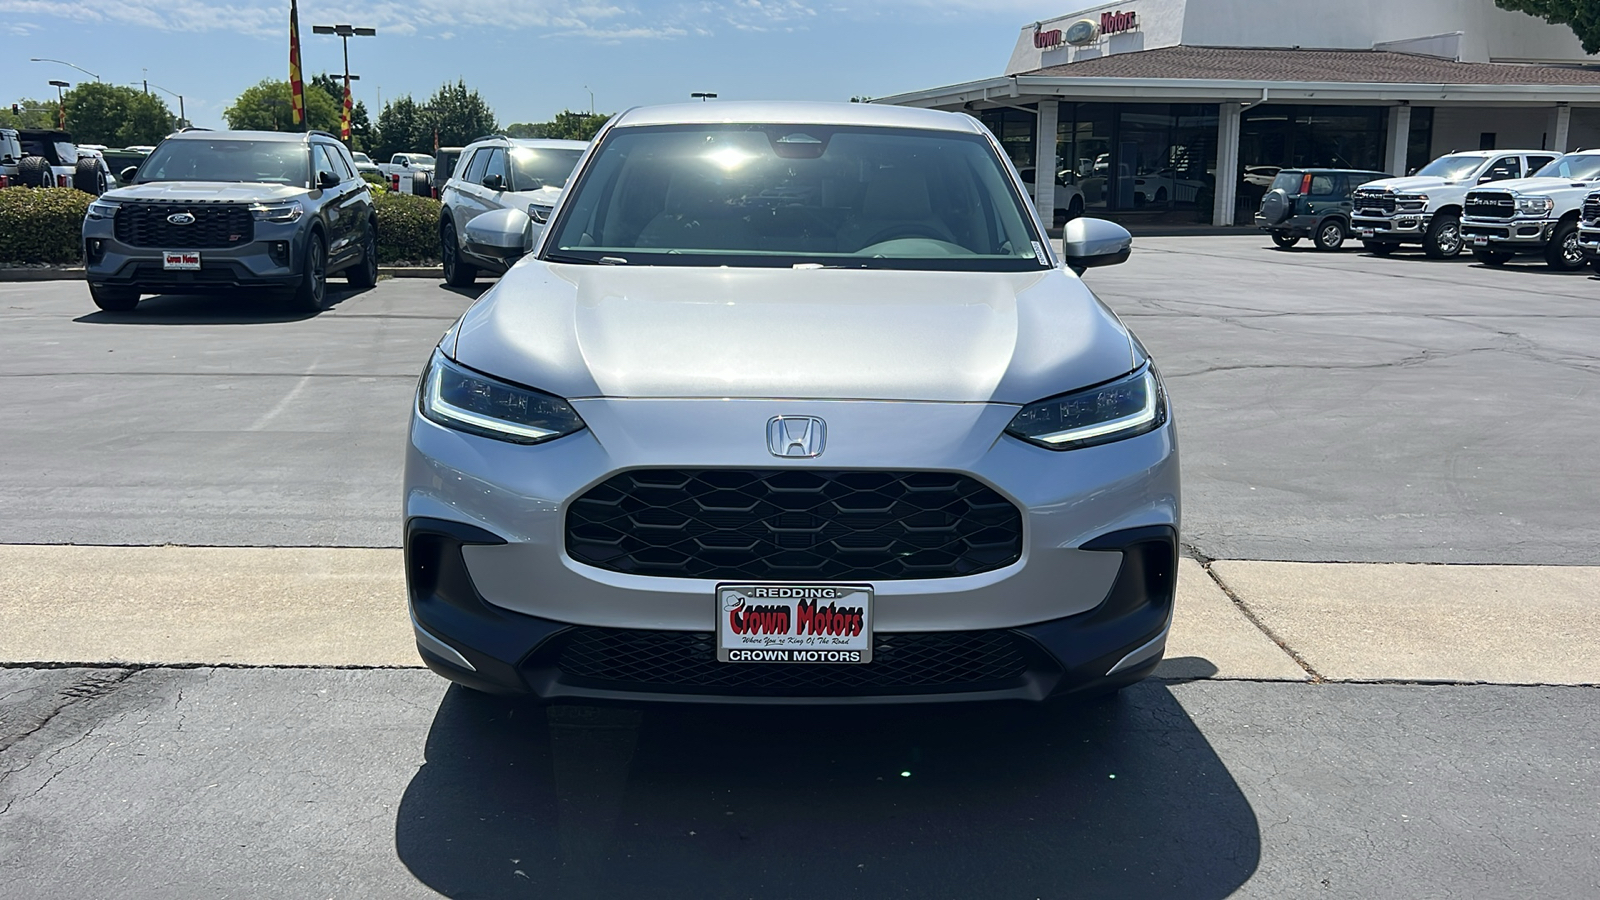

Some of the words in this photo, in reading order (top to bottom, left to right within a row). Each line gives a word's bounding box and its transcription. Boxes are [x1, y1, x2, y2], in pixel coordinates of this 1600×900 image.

[1034, 30, 1061, 48] Crown
[1100, 11, 1135, 34] Motors
[756, 588, 835, 598] REDDING
[730, 600, 791, 635] Crown
[797, 599, 864, 636] Motors
[742, 636, 762, 644] Where
[763, 637, 786, 646] You're
[787, 637, 804, 645] King
[806, 637, 815, 646] Of
[831, 637, 850, 645] Road
[729, 650, 788, 661] CROWN
[793, 651, 860, 662] MOTORS
